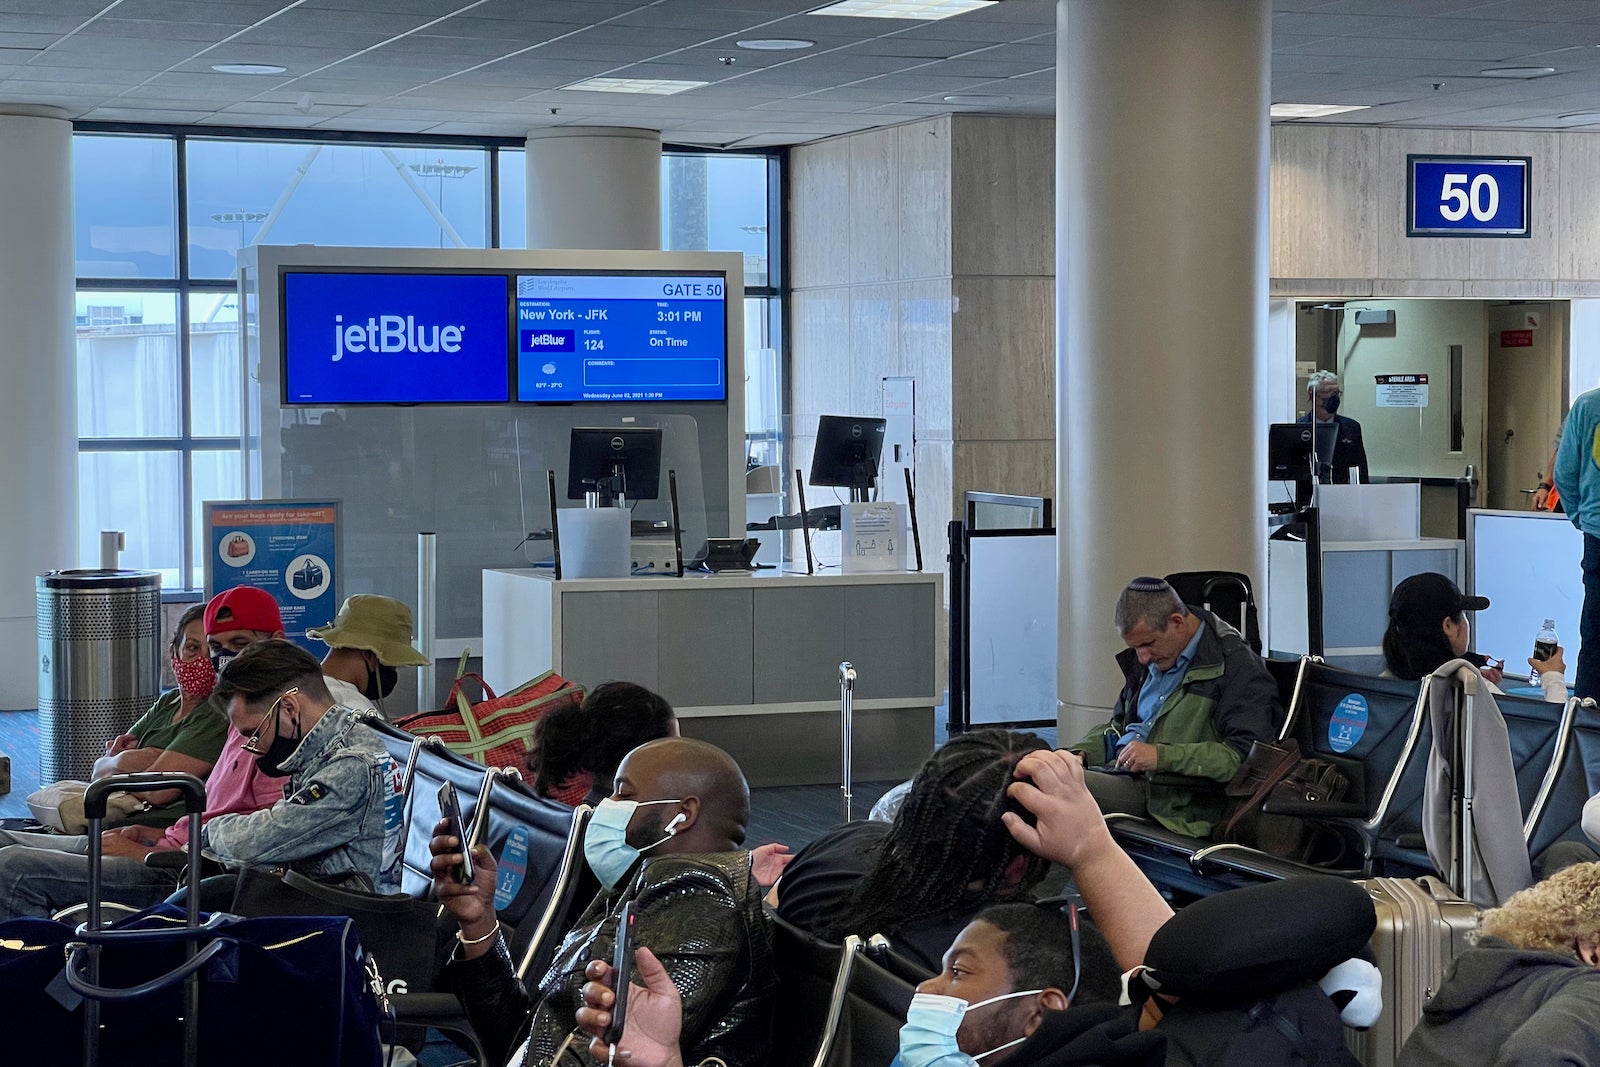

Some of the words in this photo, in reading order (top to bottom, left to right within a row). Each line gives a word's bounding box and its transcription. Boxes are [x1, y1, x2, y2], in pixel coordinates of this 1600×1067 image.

[1440, 173, 1499, 222] 50
[663, 283, 702, 296] GATE
[706, 283, 722, 296] 50
[520, 309, 546, 320] New
[548, 309, 575, 320] York
[584, 309, 608, 320] JFK
[657, 311, 680, 322] 3:01
[684, 311, 702, 322] PM
[332, 315, 465, 361] jetBlue
[531, 333, 565, 347] jetBlue
[649, 337, 663, 347] On
[665, 337, 688, 347] Time
[584, 339, 604, 350] 124
[266, 511, 284, 519] ready
